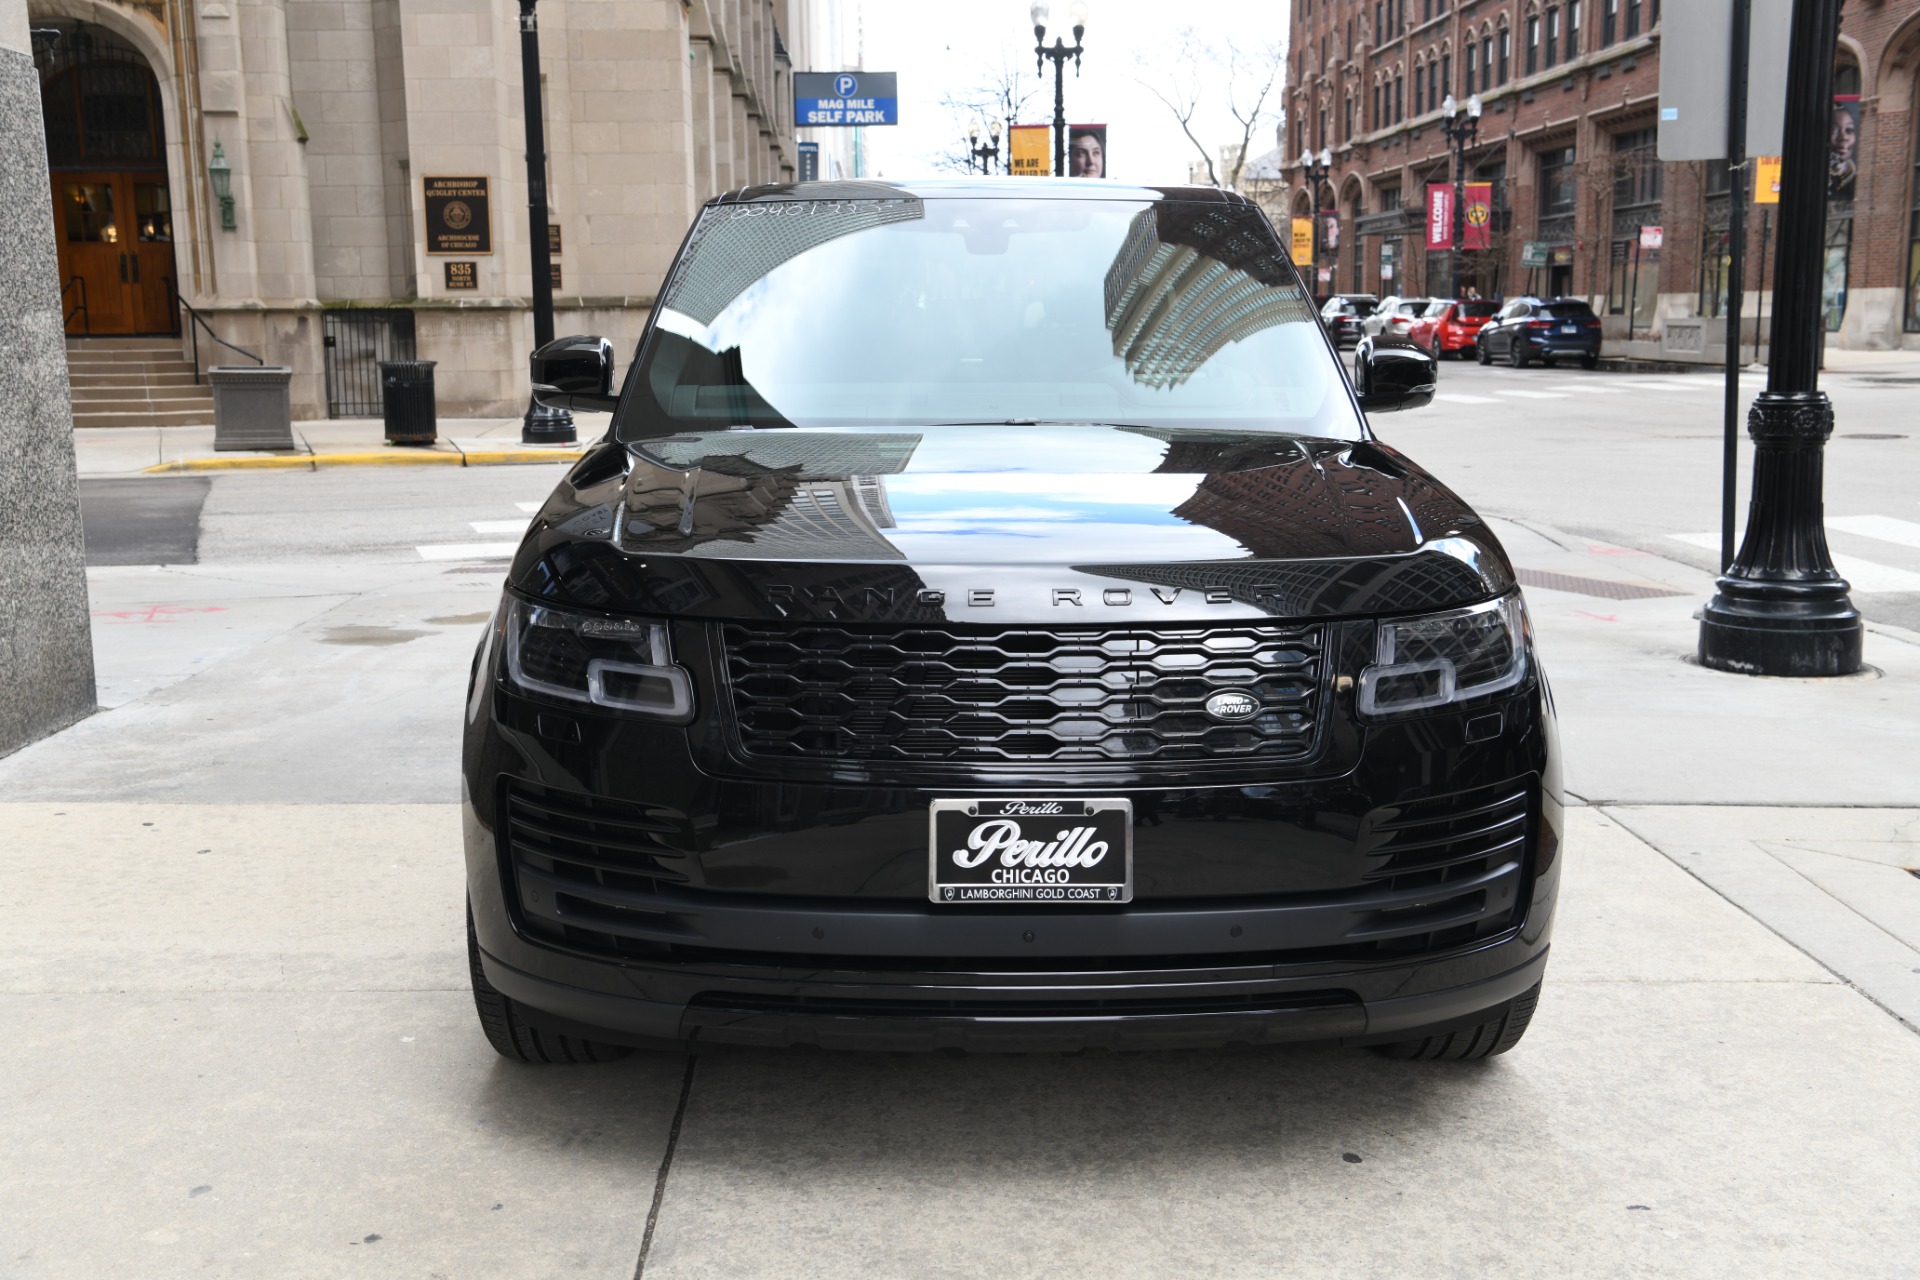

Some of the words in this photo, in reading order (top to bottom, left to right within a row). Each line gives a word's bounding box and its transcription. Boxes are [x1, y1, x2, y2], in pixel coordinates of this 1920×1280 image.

[840, 77, 853, 94] P
[818, 99, 844, 109] MAG
[847, 98, 875, 109] MILE
[807, 110, 843, 123] SELF
[846, 110, 886, 122] PARK
[798, 145, 818, 153] HOTEL
[1014, 159, 1025, 168] WE
[1026, 158, 1039, 168] ARE
[426, 189, 457, 197] QUIGLEY
[458, 189, 486, 197] CENTER
[1432, 191, 1444, 243] WELCOME
[450, 263, 471, 275] 835
[767, 584, 995, 608] RANGE
[1052, 584, 1286, 607] ROVER
[1000, 801, 1063, 815] Perillo
[952, 819, 1109, 868] Perillo
[991, 869, 1070, 884] CHICAGO
[961, 888, 1034, 899] LAMBORGHINI
[1036, 888, 1065, 899] GOLD
[1067, 888, 1101, 899] COAST
